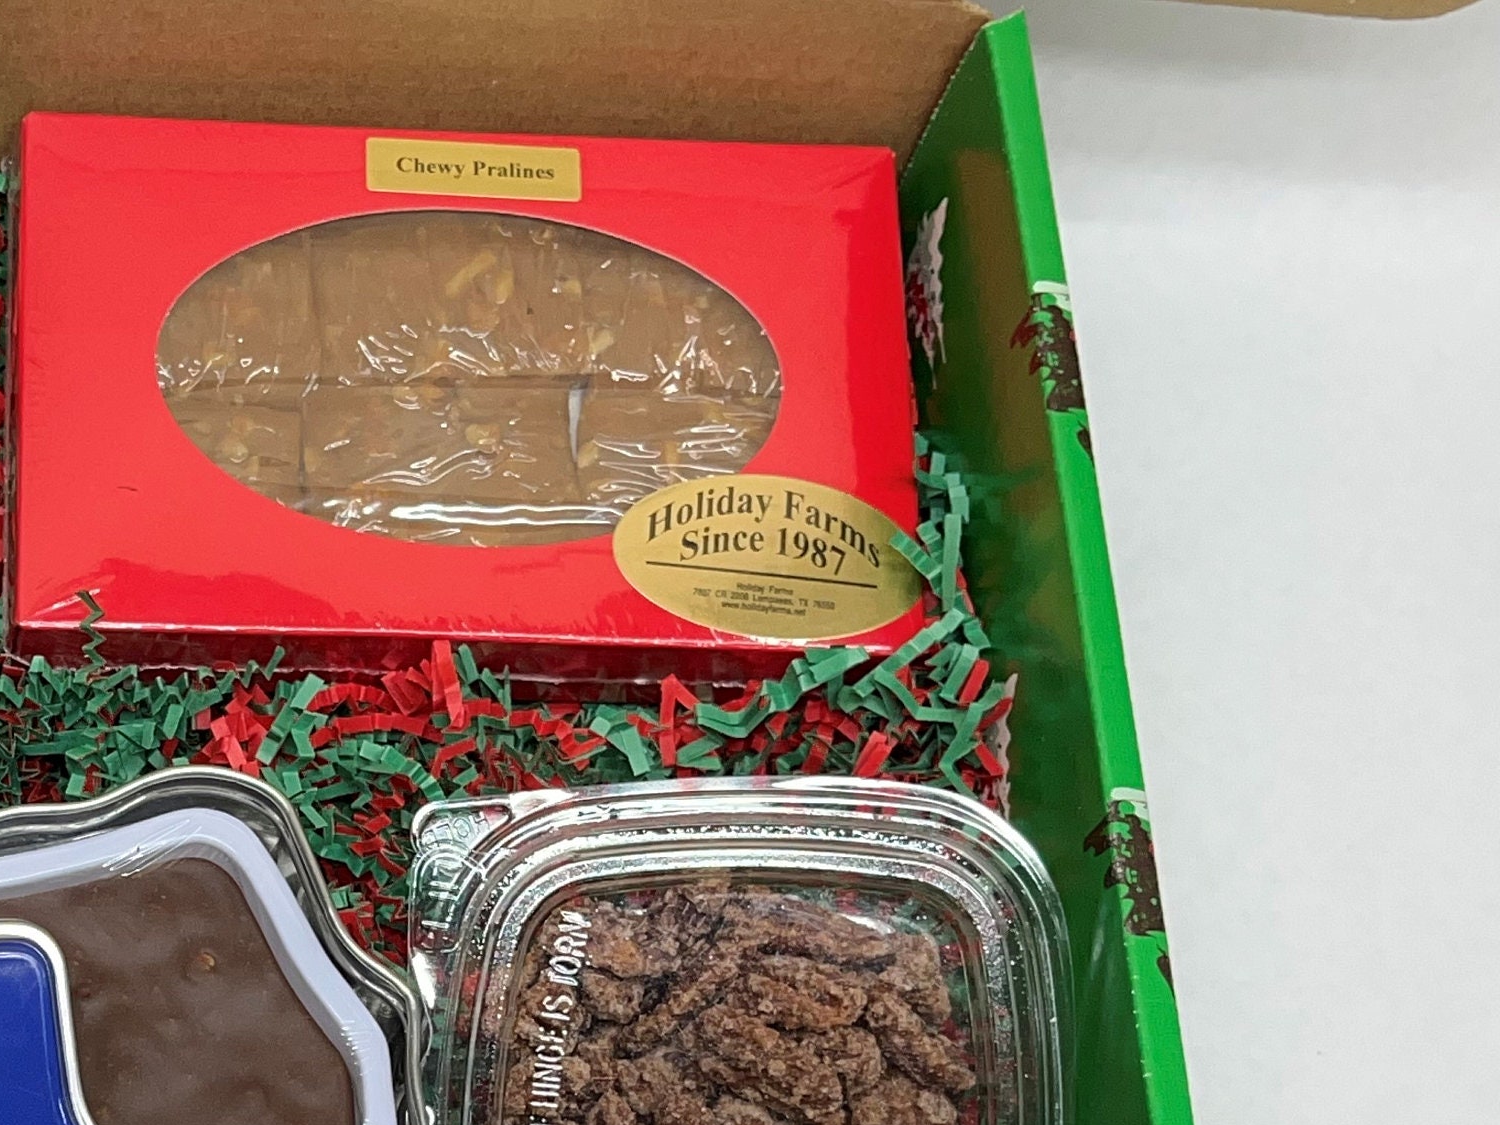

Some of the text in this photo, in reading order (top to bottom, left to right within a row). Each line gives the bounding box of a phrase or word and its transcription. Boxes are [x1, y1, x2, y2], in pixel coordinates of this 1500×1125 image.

[396, 156, 555, 180] Chewy Pralines
[646, 486, 880, 569] Holiday Farms
[679, 526, 847, 576] Since 1987
[540, 994, 574, 1021] IS
